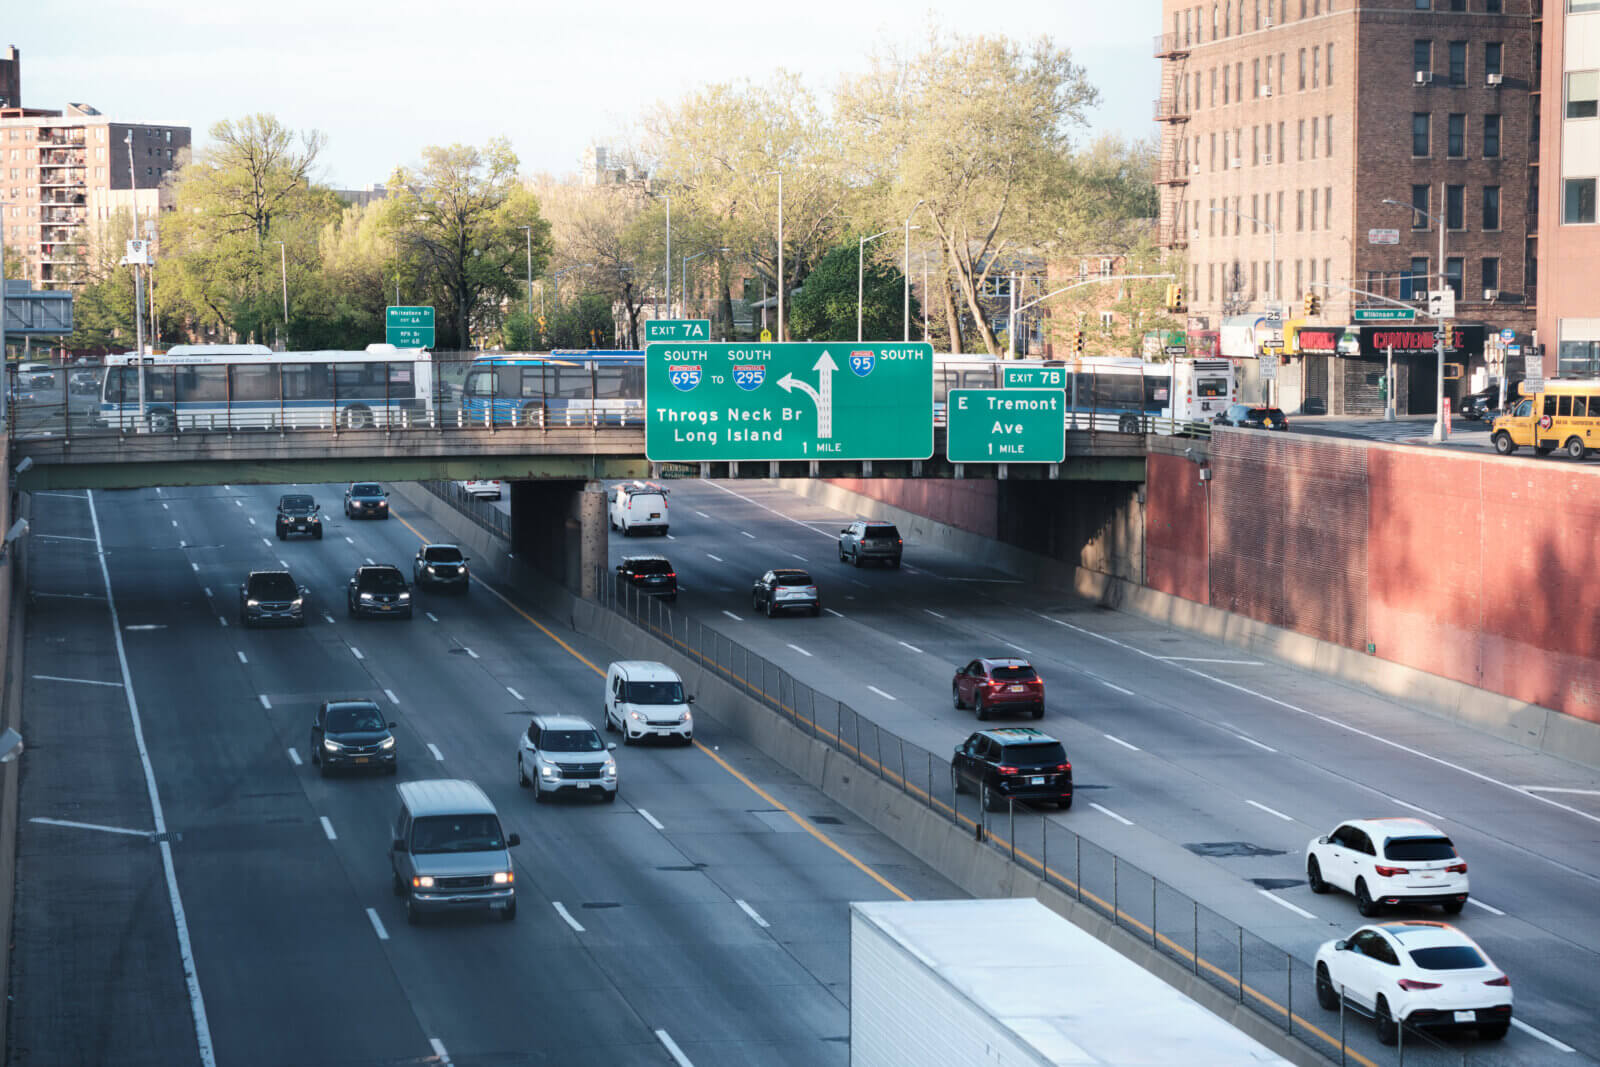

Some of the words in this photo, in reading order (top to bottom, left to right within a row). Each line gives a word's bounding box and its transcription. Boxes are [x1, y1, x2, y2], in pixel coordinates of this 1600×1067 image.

[1267, 312, 1281, 321] 25
[651, 326, 676, 336] EXIT
[682, 324, 704, 337] 7A
[664, 350, 708, 361] SOUTH
[727, 350, 772, 360] SOUTH
[852, 357, 871, 370] 95
[880, 350, 923, 360] SOUTH
[672, 372, 699, 385] 695
[711, 375, 724, 384] TO
[736, 371, 763, 384] 295
[1009, 373, 1034, 383] EXIT
[1039, 371, 1061, 384] 7B
[958, 397, 968, 410] E
[986, 397, 1057, 410] Tremont
[656, 408, 719, 425] Throgs
[728, 408, 772, 421] Neck
[782, 408, 802, 421] Br
[991, 421, 1024, 434] Ave
[674, 428, 717, 445] Long
[727, 428, 783, 442] Island
[802, 442, 808, 454] 1
[816, 443, 842, 452] MILE
[988, 443, 993, 455] 1
[999, 444, 1025, 454] MILE
